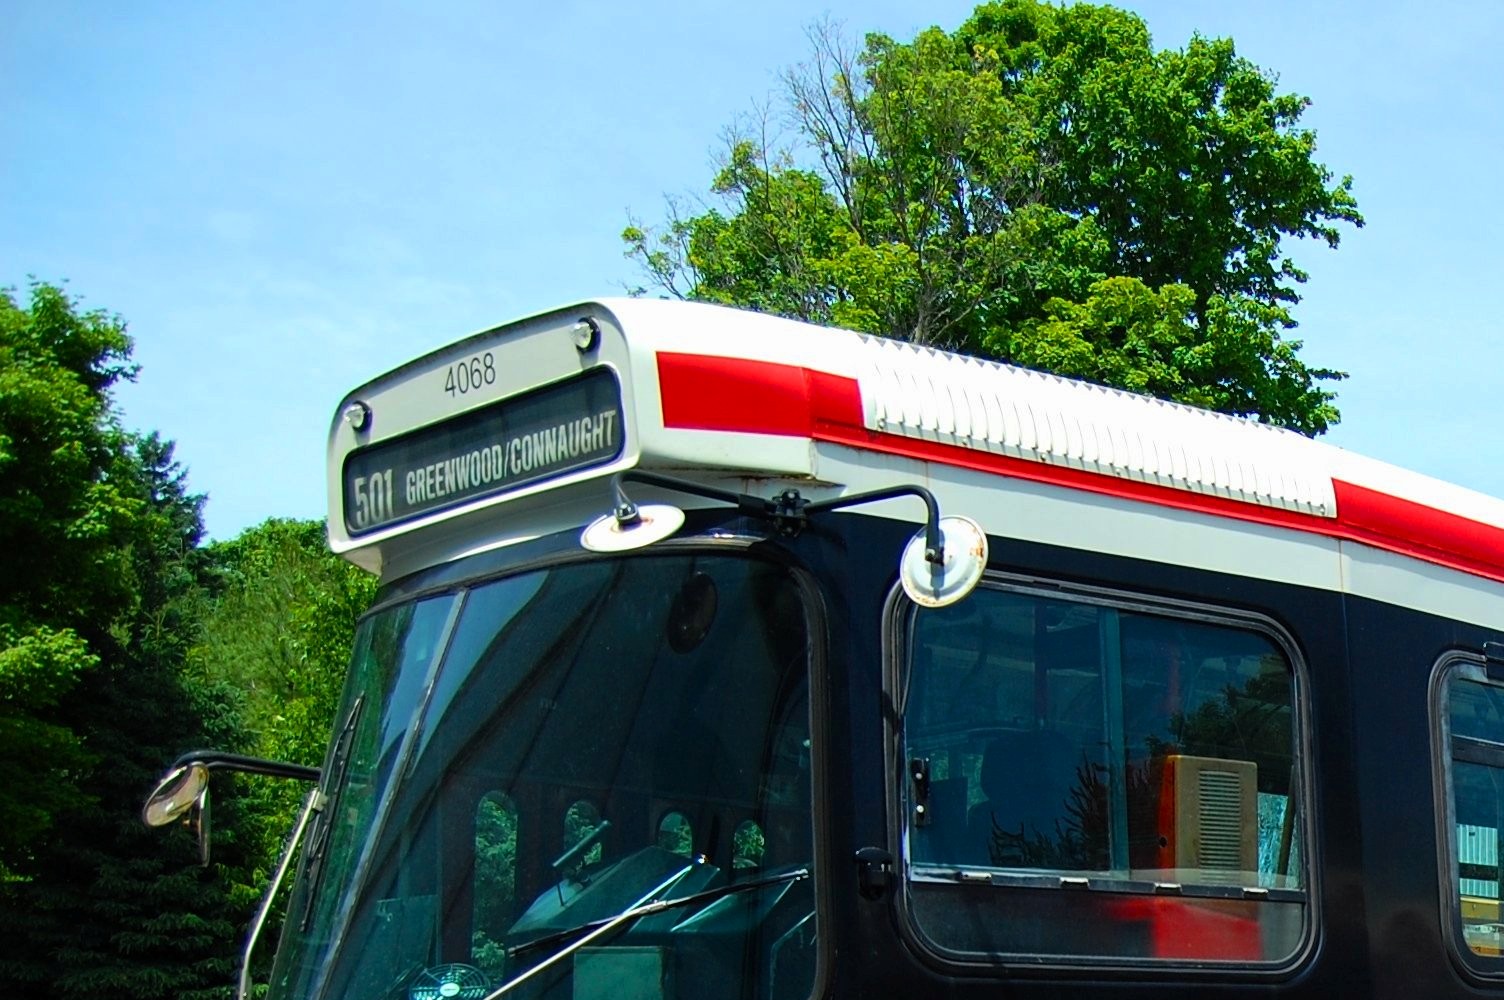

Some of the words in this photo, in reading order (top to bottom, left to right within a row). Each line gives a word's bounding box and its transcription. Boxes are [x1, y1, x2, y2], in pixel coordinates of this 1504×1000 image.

[445, 352, 496, 398] 4068
[354, 469, 395, 528] 501
[406, 409, 616, 505] GREENWOOD/CONNAUGHT
